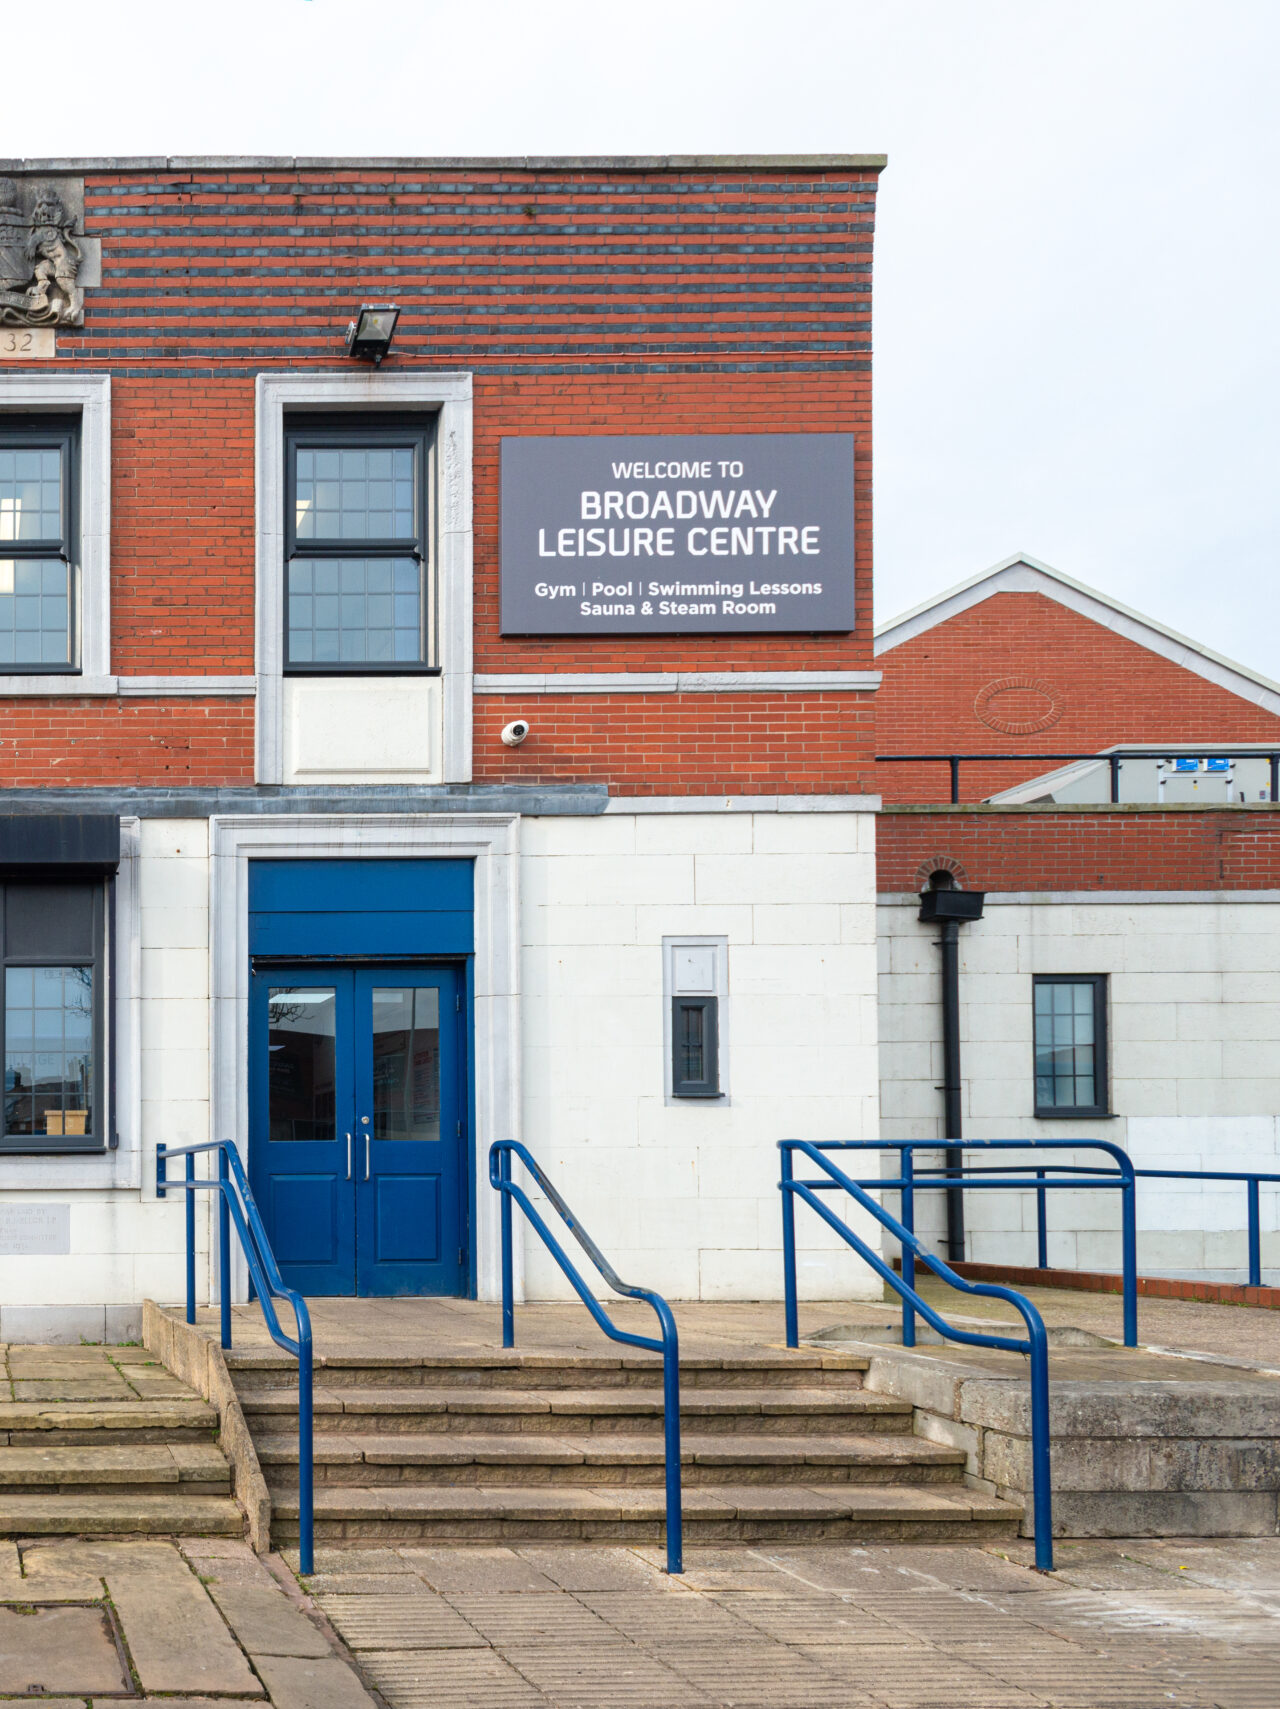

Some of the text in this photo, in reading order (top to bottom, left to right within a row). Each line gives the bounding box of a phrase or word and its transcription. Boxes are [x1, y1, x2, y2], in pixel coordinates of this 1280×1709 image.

[612, 461, 743, 478] WELCOME TO
[581, 490, 777, 519] BROADWAY
[539, 526, 820, 556] LEISURE CENTRE
[535, 581, 822, 599] Gym Pool Swimming Lessons
[581, 601, 776, 615] Sauna & Steam Room
